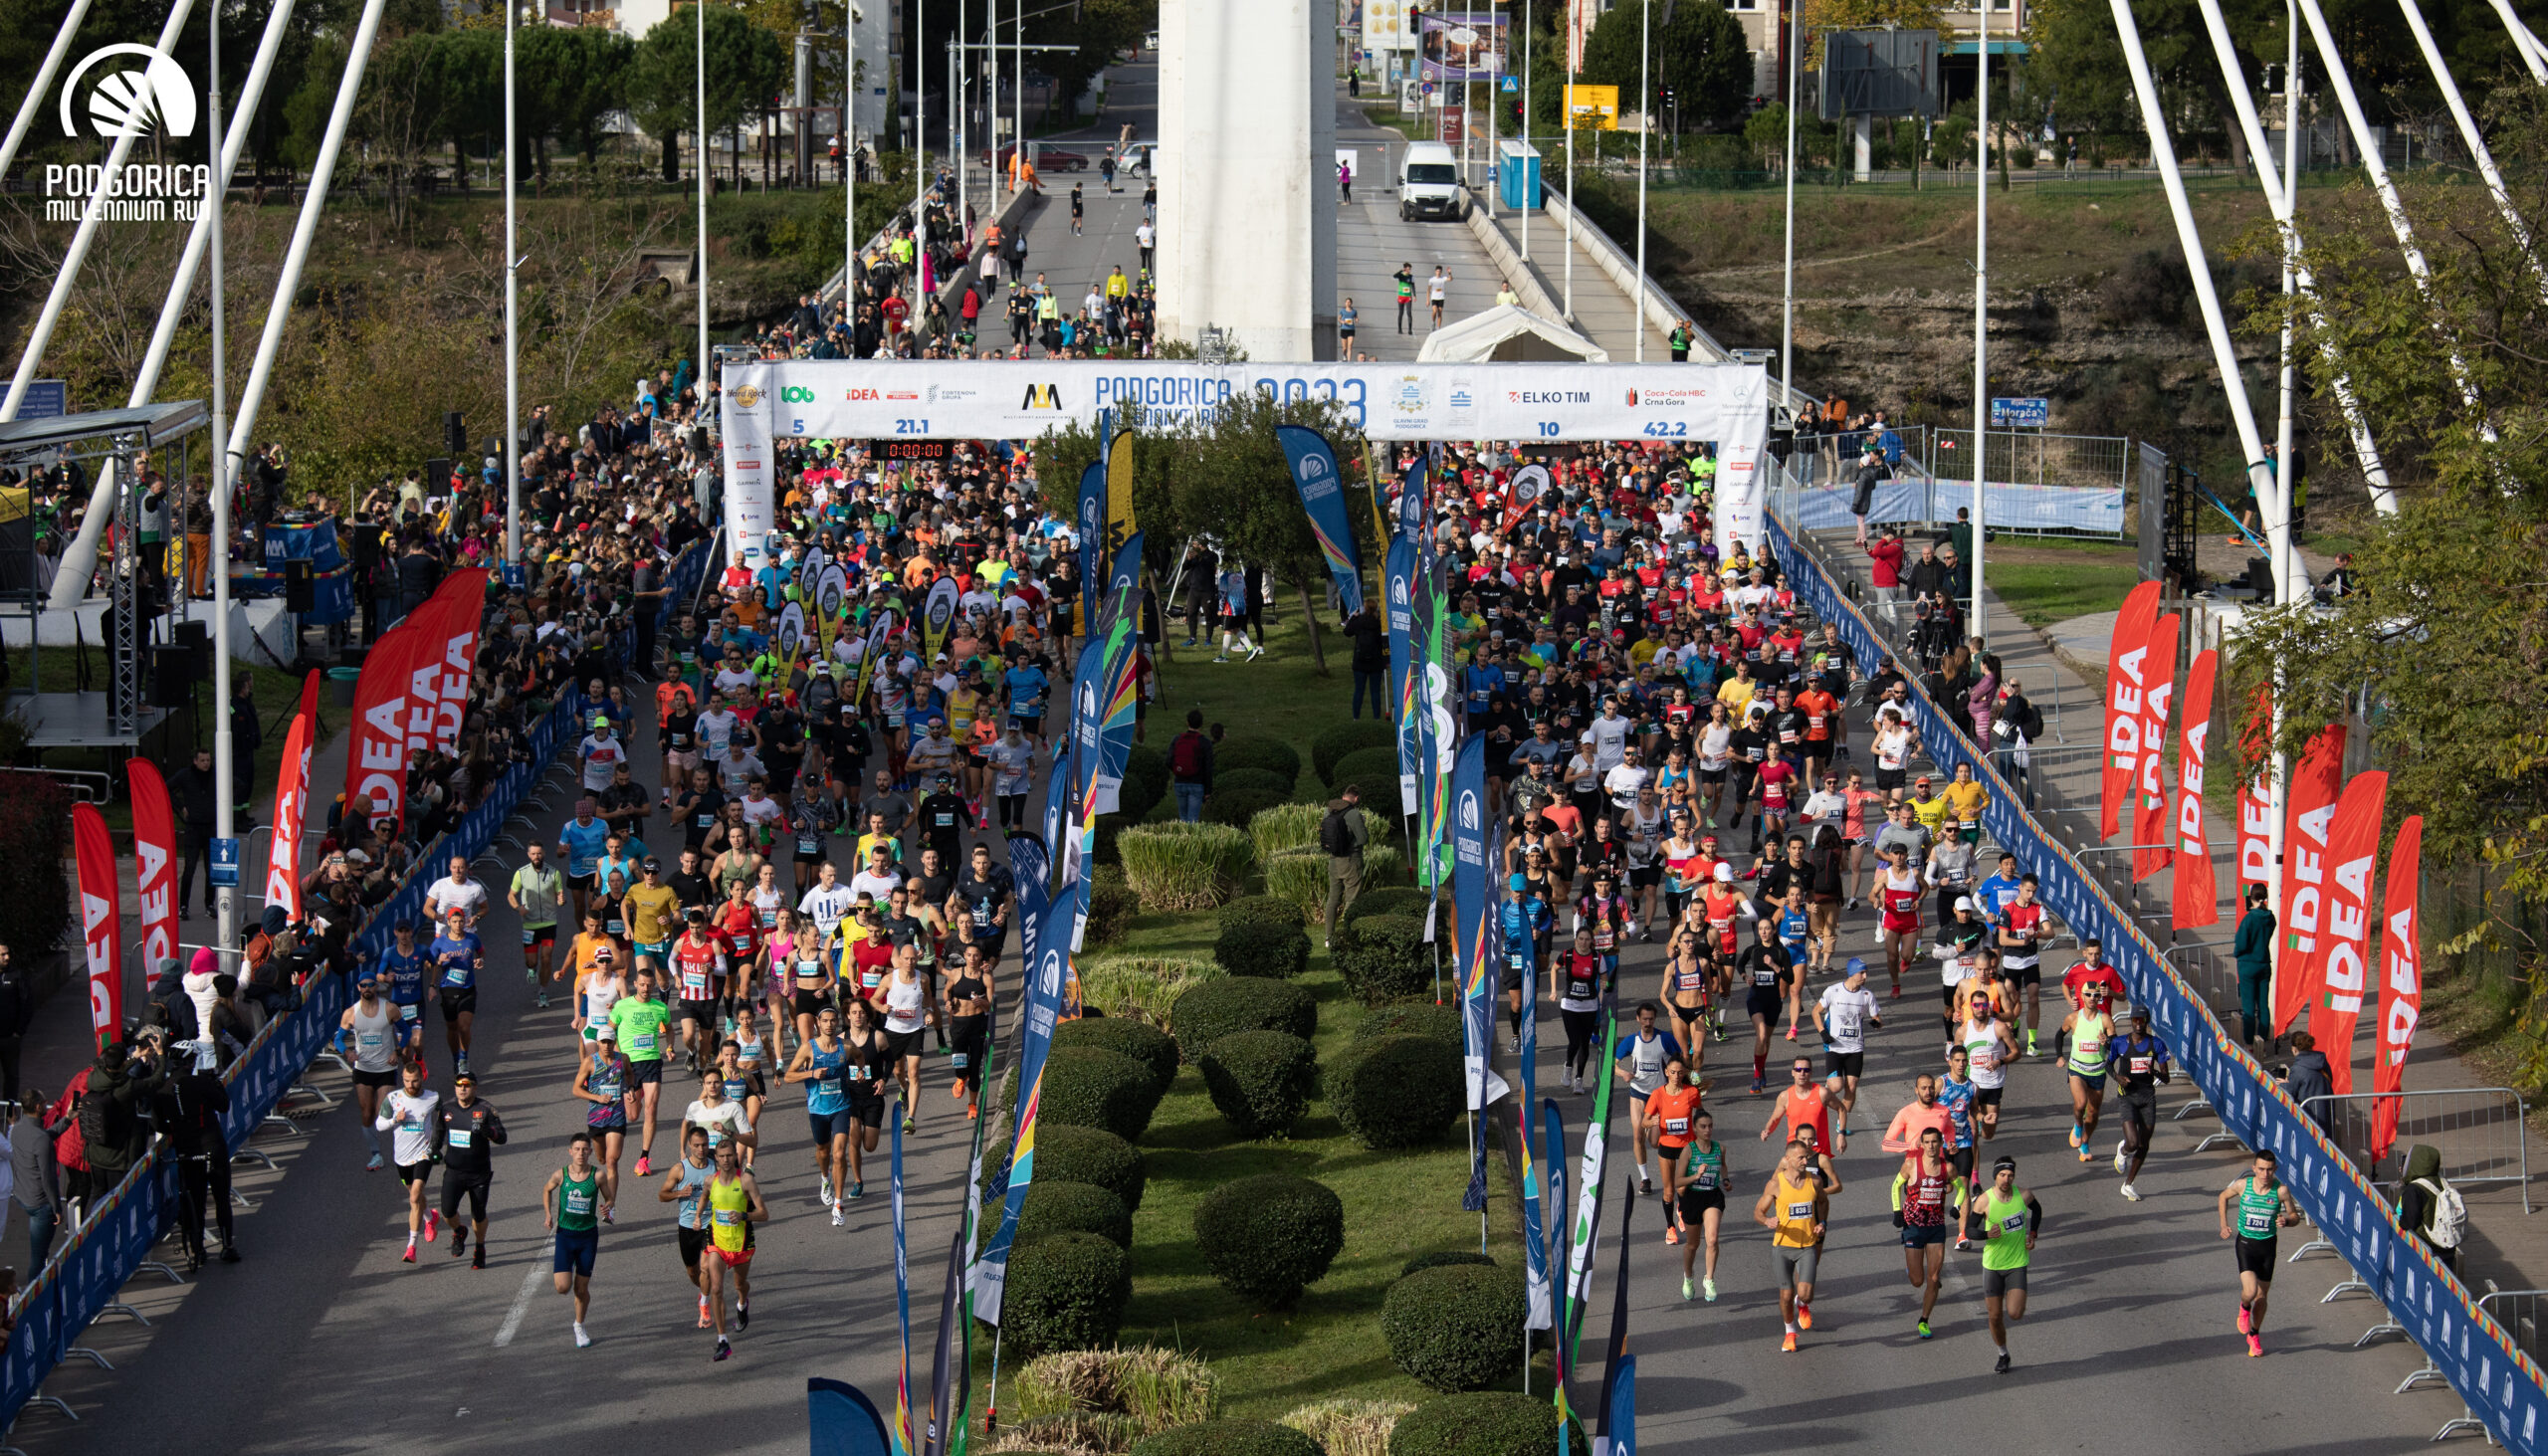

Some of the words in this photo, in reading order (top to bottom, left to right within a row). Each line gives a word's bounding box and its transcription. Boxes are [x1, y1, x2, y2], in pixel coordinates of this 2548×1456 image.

[1096, 377, 1231, 405] PODGORICA
[1523, 391, 1563, 403] ELKO
[1566, 391, 1591, 403] TIM
[792, 419, 804, 434] 5
[896, 419, 929, 434] 21.1
[1538, 421, 1560, 437] 10
[1643, 421, 1687, 437] 42.2
[889, 444, 944, 457] 0:00:00
[2110, 645, 2147, 771] iDEA
[2180, 720, 2209, 856] iDEA
[2324, 854, 2374, 1014] iDEA
[2384, 907, 2419, 1067] iDEA
